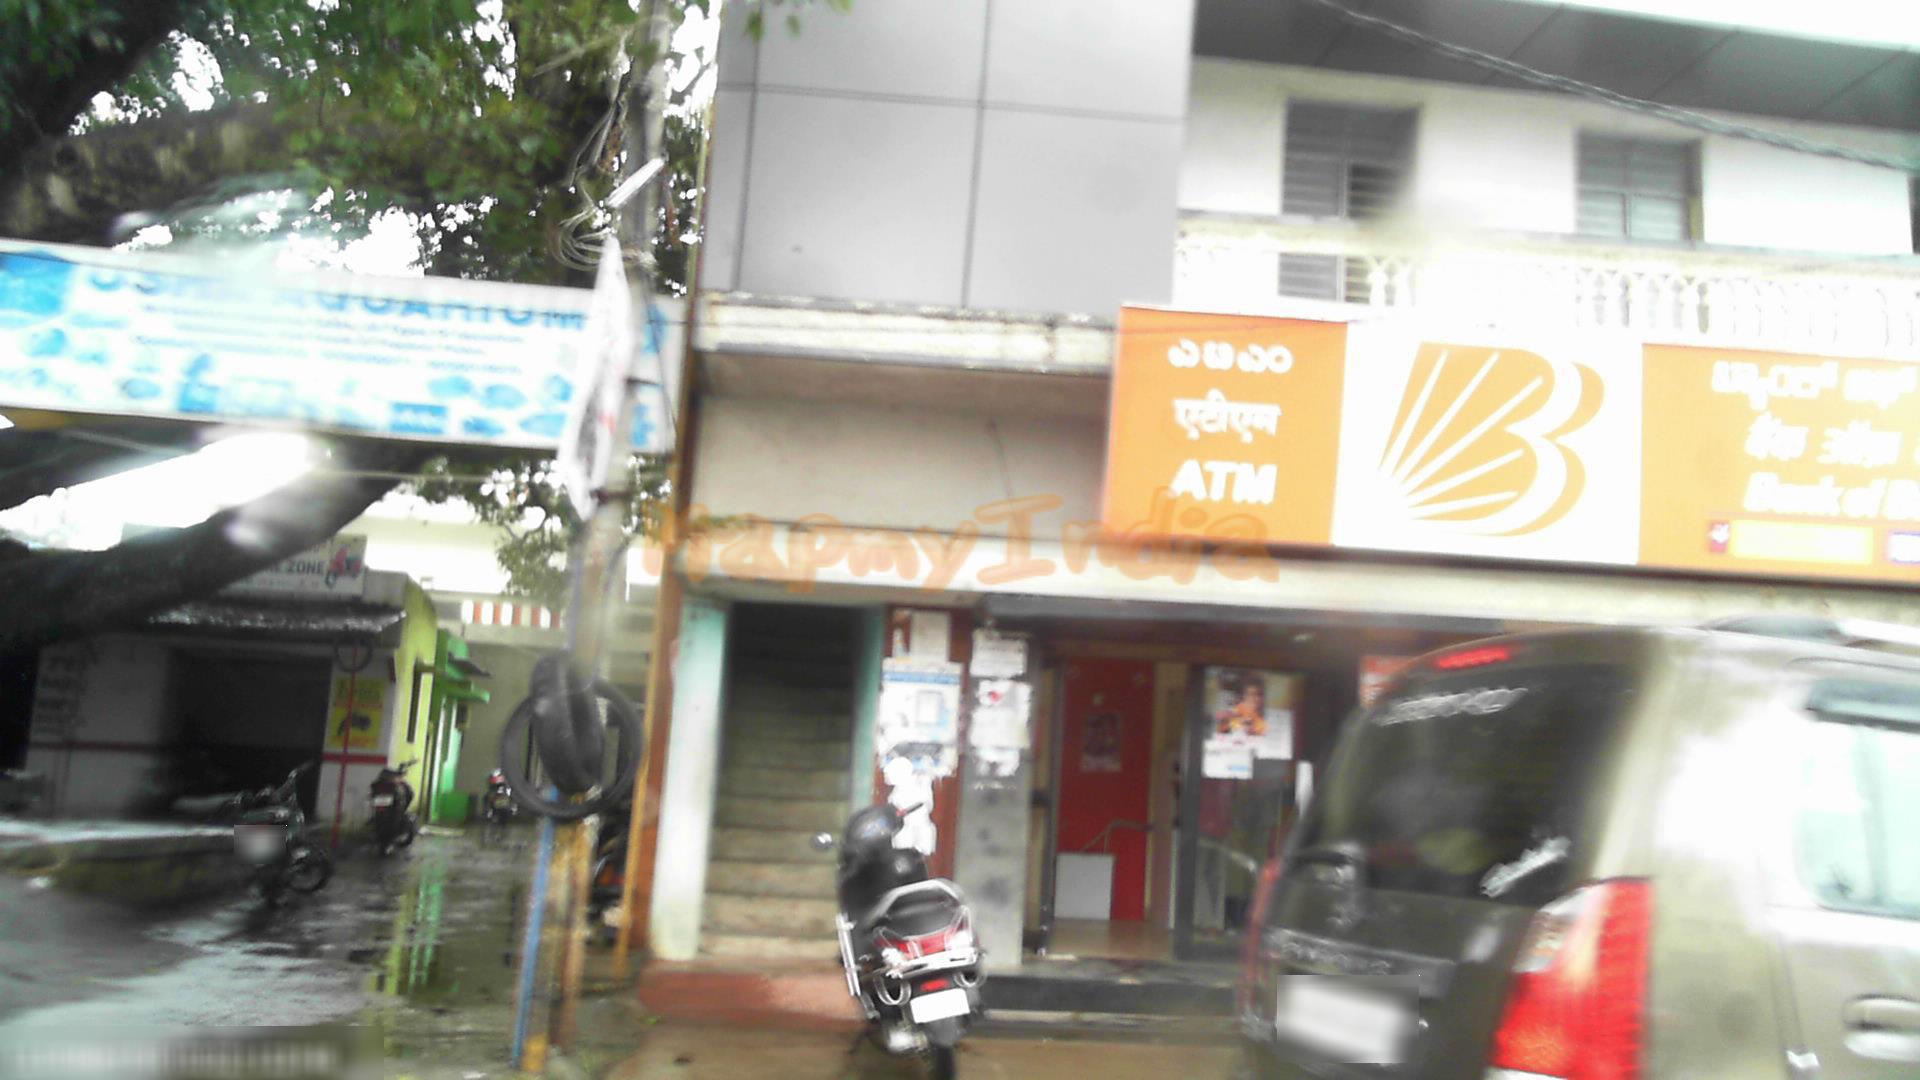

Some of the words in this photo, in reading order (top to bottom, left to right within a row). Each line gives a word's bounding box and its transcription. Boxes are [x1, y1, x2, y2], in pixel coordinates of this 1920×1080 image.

[1168, 459, 1278, 504] ATM
[1743, 471, 1841, 516] Bank
[1842, 478, 1887, 519] of
[1884, 479, 1920, 521] B
[288, 560, 324, 575] ZONE
